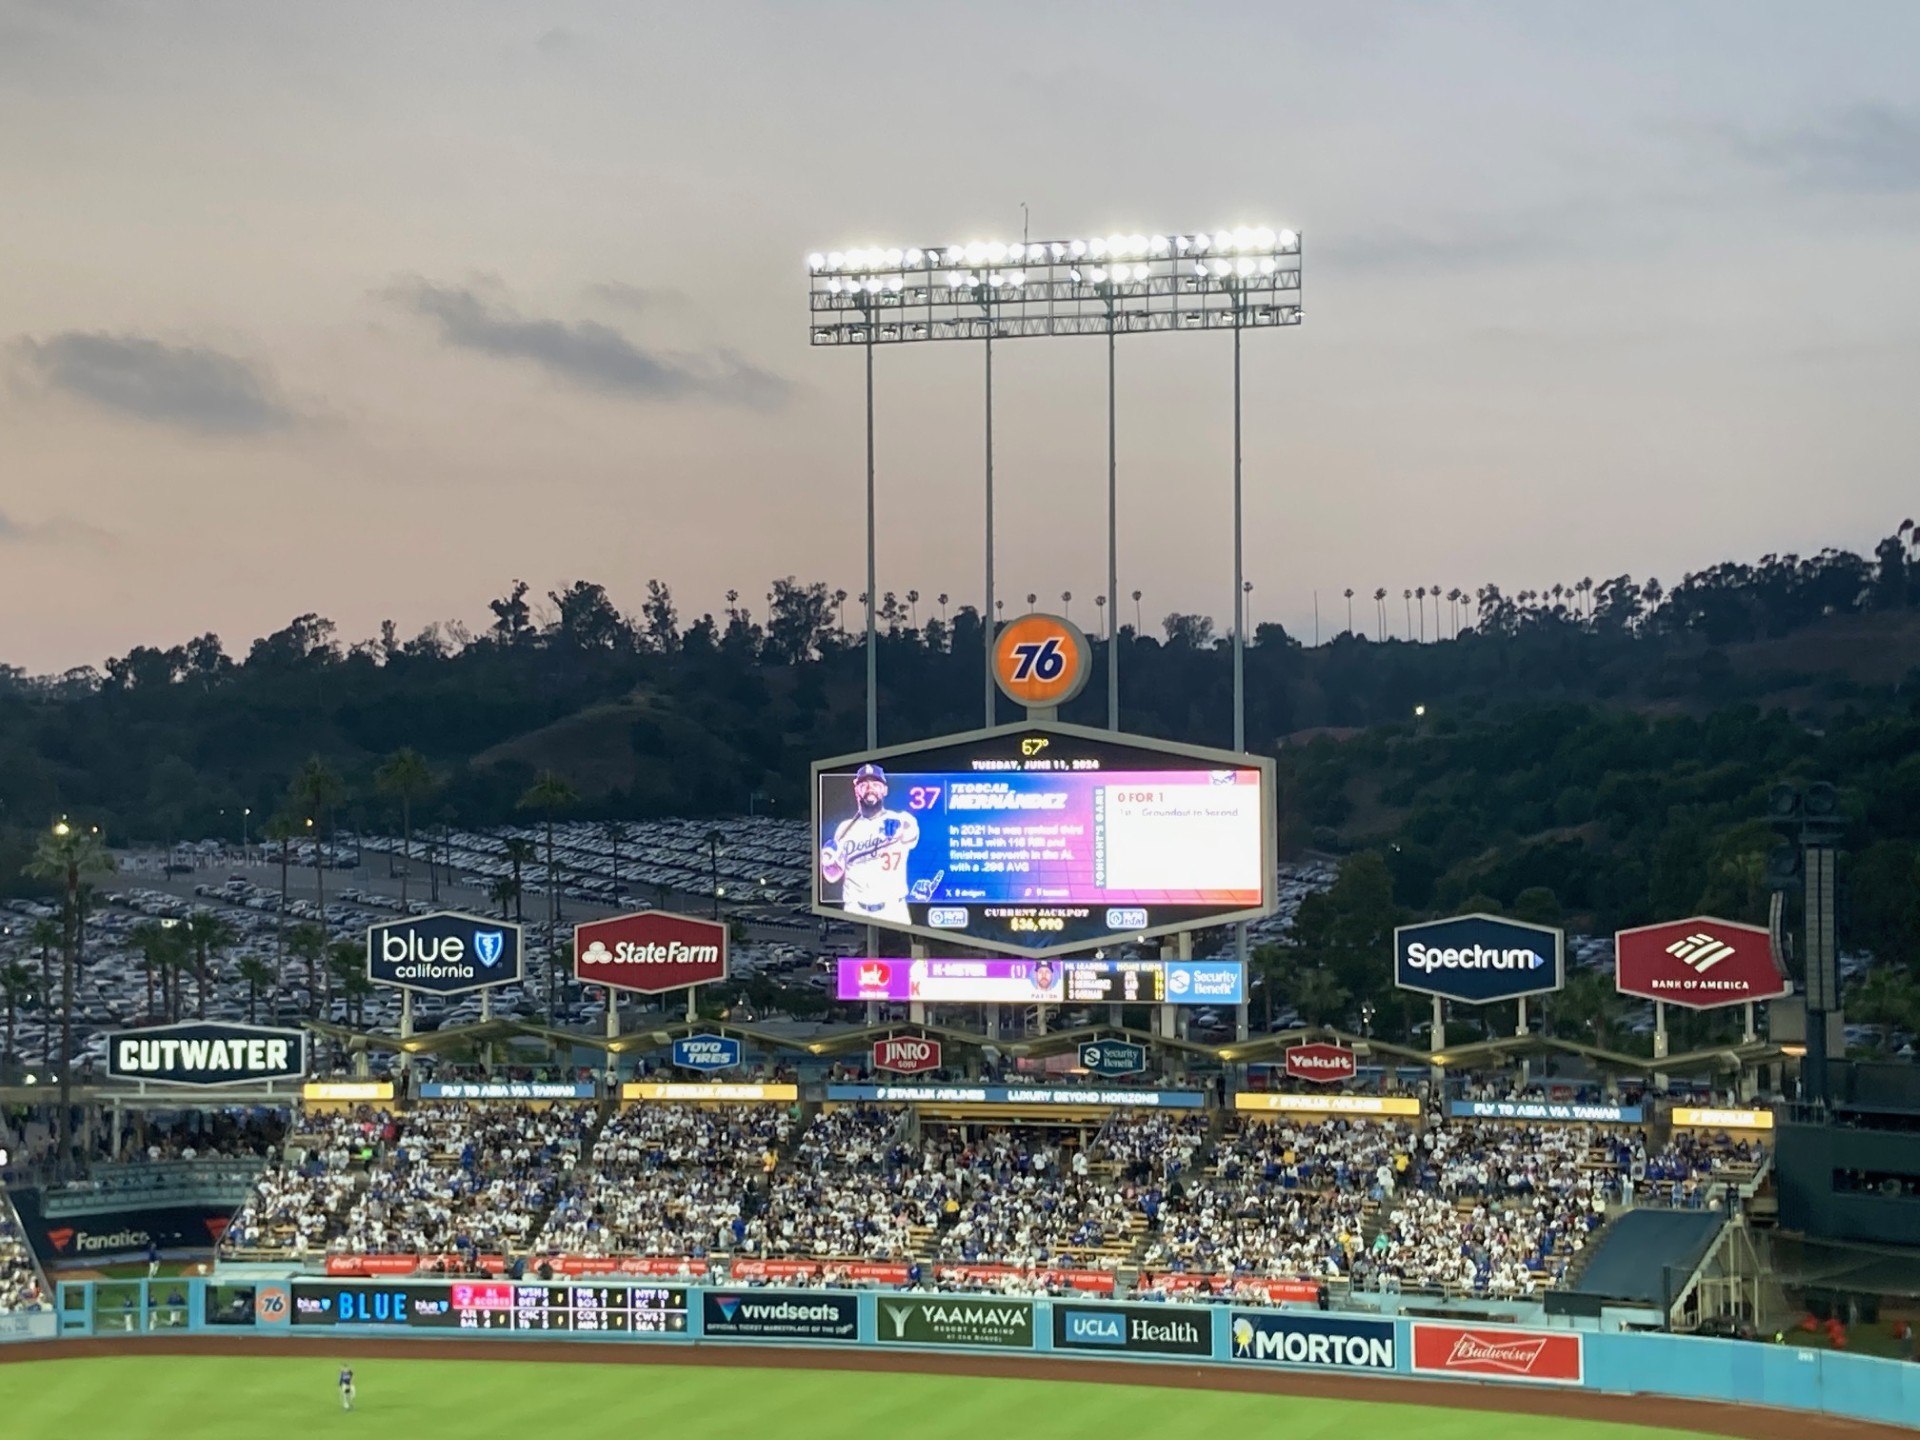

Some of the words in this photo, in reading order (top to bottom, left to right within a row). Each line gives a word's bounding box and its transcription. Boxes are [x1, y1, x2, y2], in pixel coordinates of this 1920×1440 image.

[1010, 637, 1065, 682] 76
[1022, 739, 1049, 755] 67°
[972, 760, 1021, 770] TUESDAY,
[1024, 760, 1050, 770] JUNE
[1053, 760, 1069, 770] 11,
[1072, 760, 1100, 770] 2024
[909, 787, 941, 809] 37
[1118, 792, 1126, 802] 0
[1129, 792, 1154, 802] FOR
[1159, 792, 1164, 802] 1
[880, 852, 902, 871] 37
[984, 908, 1038, 918] CURRENT
[1038, 909, 1090, 918] JACKPOT
[383, 929, 465, 963] blue
[1407, 943, 1535, 974] Spectrum
[395, 962, 474, 979] california
[1194, 970, 1238, 986] Security
[1194, 983, 1234, 994] Benefit
[1652, 980, 1682, 988] BANK
[1684, 980, 1699, 988] OF
[1700, 980, 1749, 990] AMERICA
[119, 1039, 288, 1071] CUTWATER
[682, 1042, 722, 1052] TOYO
[885, 1043, 930, 1064] JINRO
[1104, 1049, 1140, 1060] Security
[688, 1052, 731, 1064] TIRES
[1104, 1058, 1134, 1068] Benefit
[1290, 1056, 1352, 1070] Yakult
[464, 1085, 480, 1097] TO
[512, 1086, 530, 1098] VIA
[1008, 1090, 1051, 1101] LUXURY
[1054, 1091, 1100, 1102] BEYOND
[1102, 1092, 1158, 1104] HORIZONS
[1498, 1104, 1515, 1116] TO
[1550, 1106, 1570, 1118] VIA
[76, 1228, 150, 1250] Fanatics
[658, 1290, 670, 1300] 10
[264, 1296, 283, 1312] 76
[338, 1292, 408, 1320] BLUE
[741, 1302, 840, 1321] vividseats
[1074, 1320, 1120, 1337] UCLA
[1131, 1320, 1198, 1344] Health
[1256, 1330, 1393, 1368] MORTON
[1454, 1340, 1536, 1362] Budweiser
